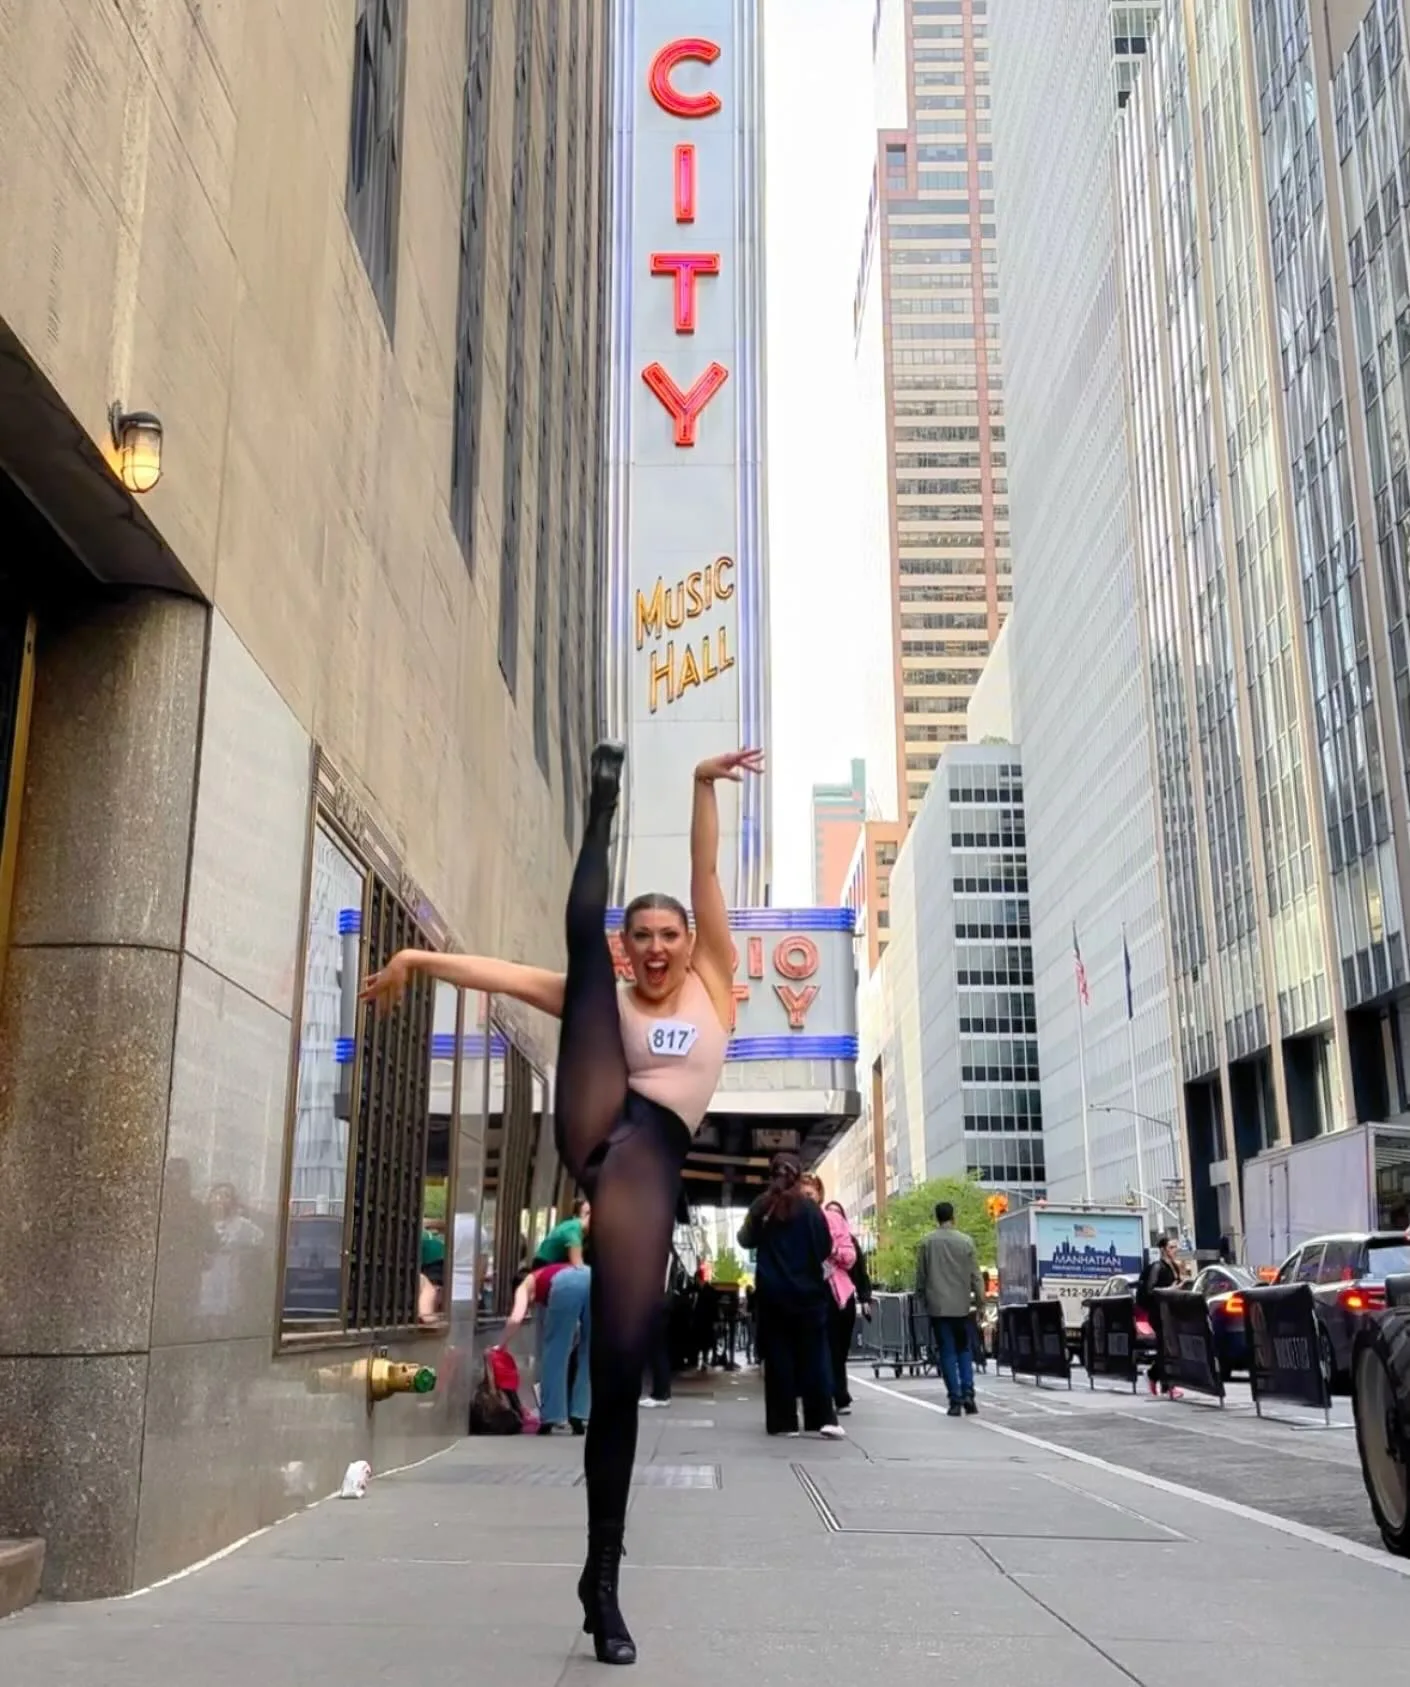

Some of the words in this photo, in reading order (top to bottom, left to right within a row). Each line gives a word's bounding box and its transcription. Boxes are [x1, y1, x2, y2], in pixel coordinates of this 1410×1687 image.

[642, 38, 729, 447] CITY
[635, 556, 735, 651] MUSIC
[649, 626, 735, 715] HALL
[652, 1028, 690, 1049] 817
[1054, 1255, 1122, 1267] MANHATTAN
